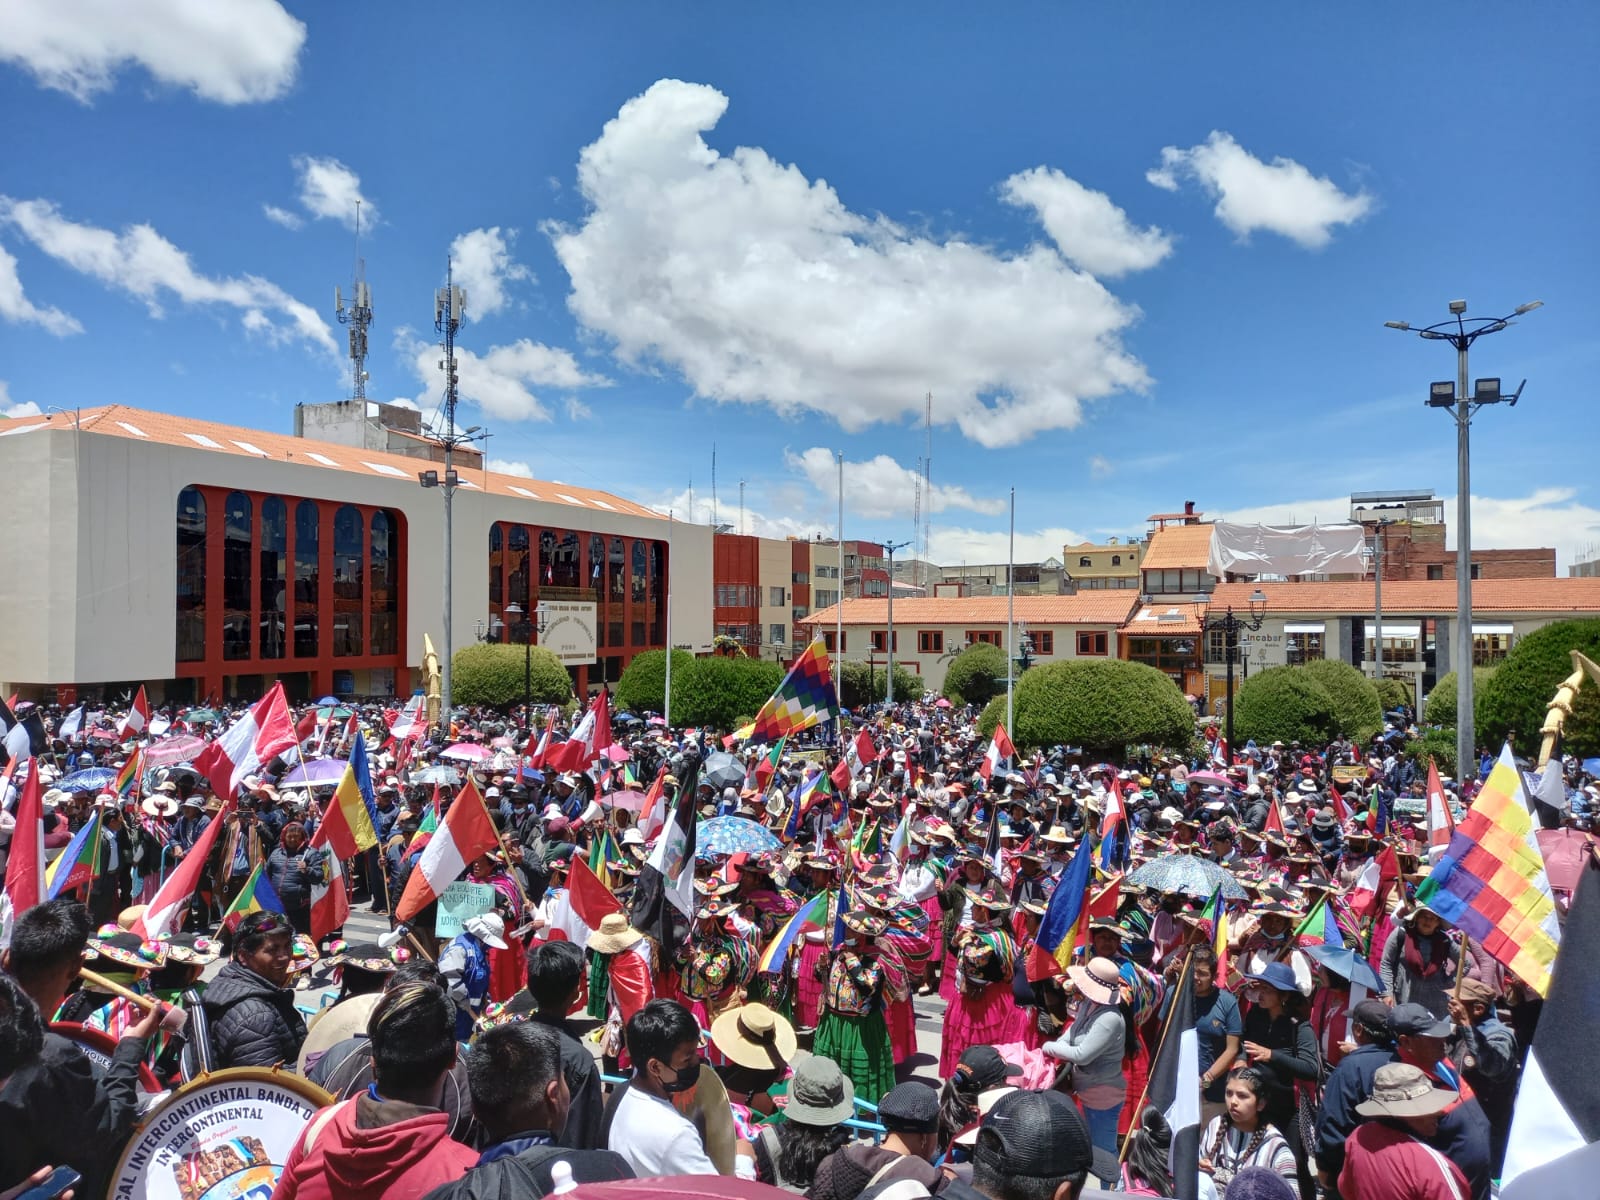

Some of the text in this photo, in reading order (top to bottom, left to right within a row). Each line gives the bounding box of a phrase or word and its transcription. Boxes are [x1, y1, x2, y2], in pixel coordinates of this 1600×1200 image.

[1247, 633, 1283, 642] Incabar
[128, 1087, 252, 1171] INTERCONTINENTAL
[257, 1088, 301, 1115] BANDA
[155, 1106, 264, 1167] INTERCONTINENTAL
